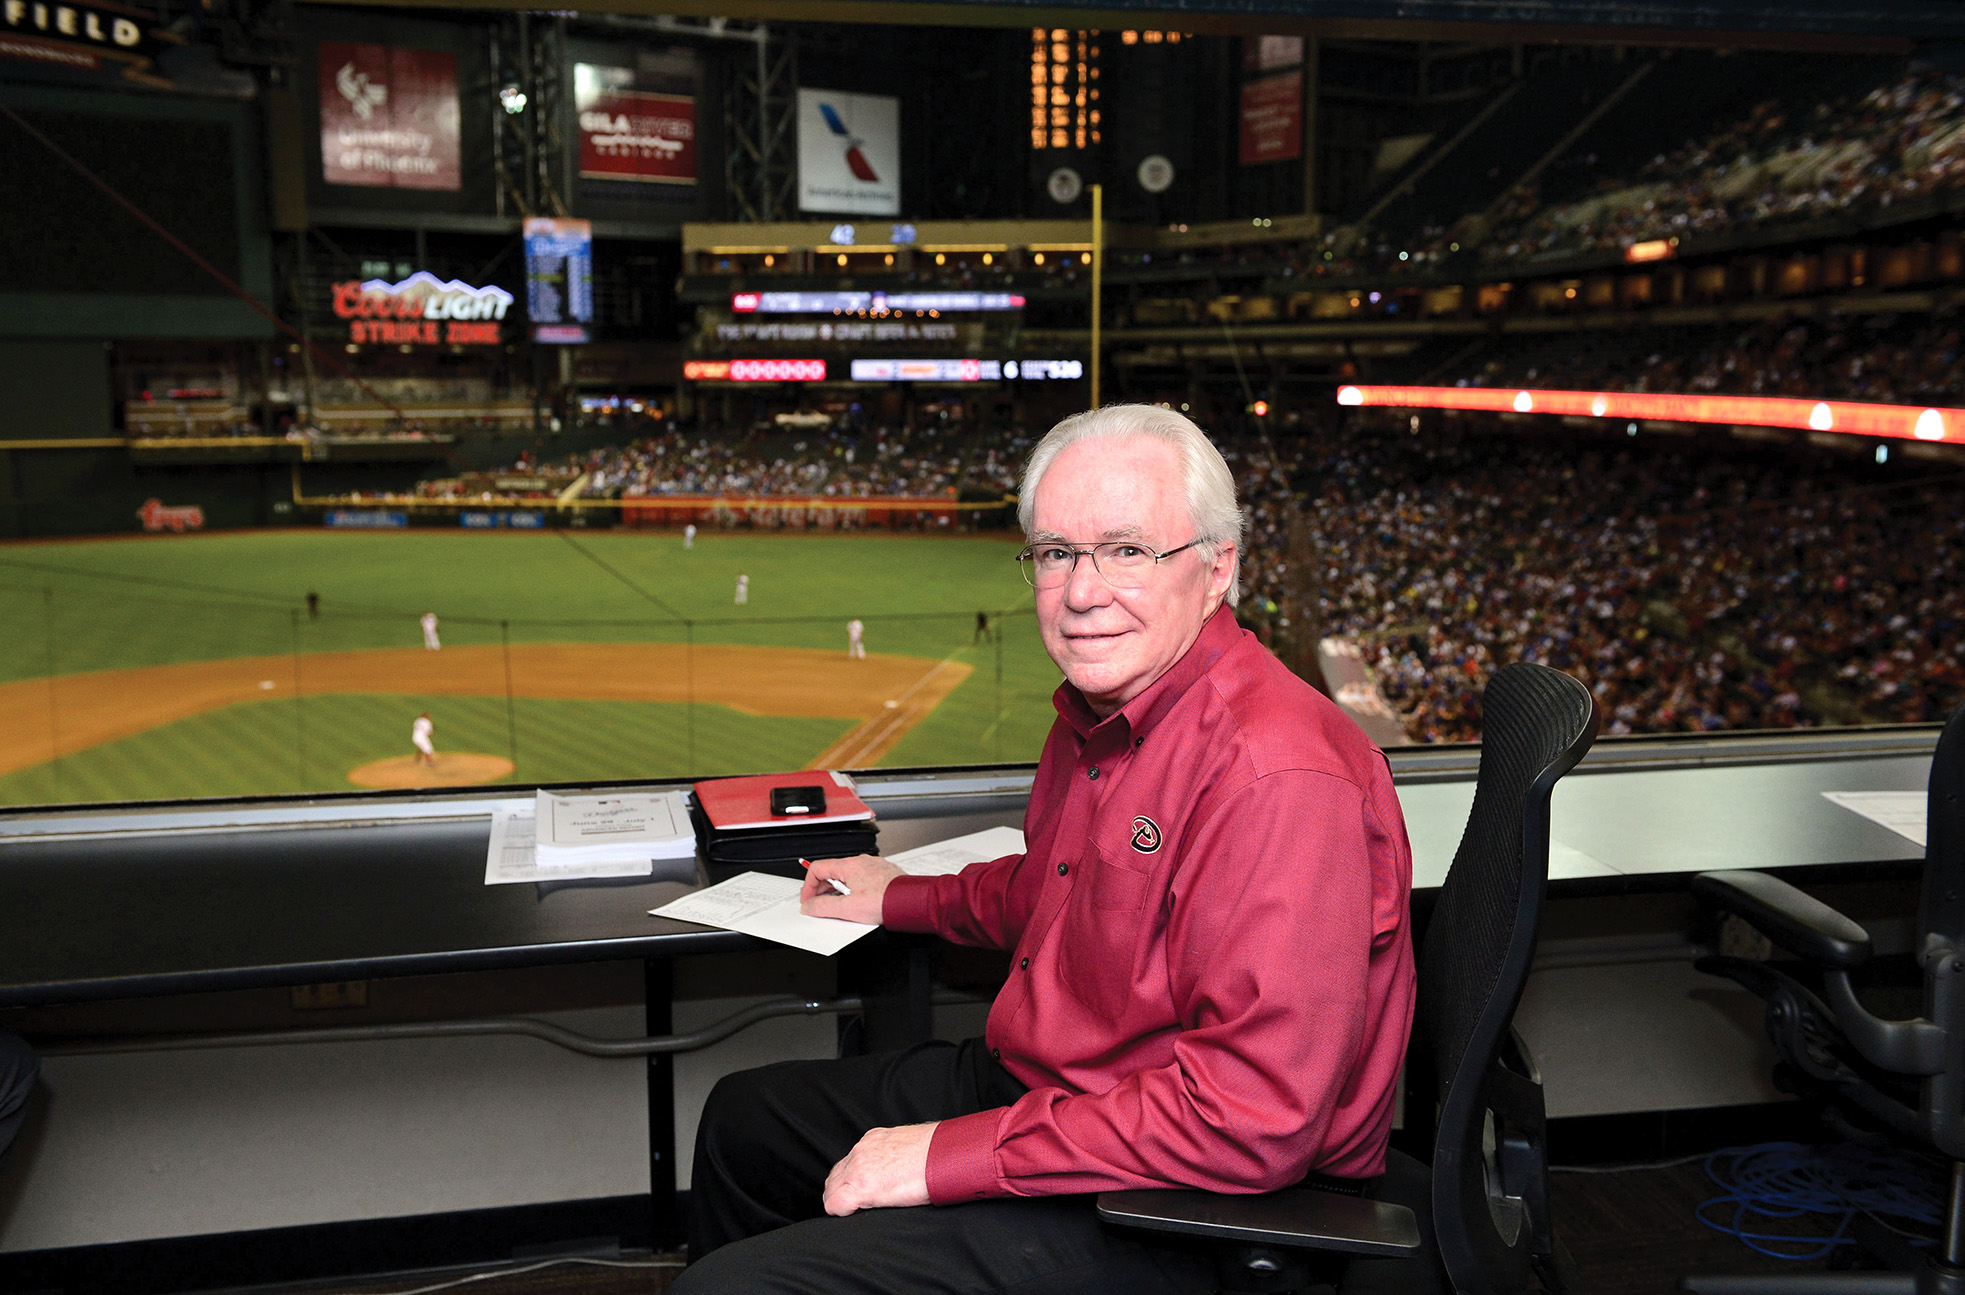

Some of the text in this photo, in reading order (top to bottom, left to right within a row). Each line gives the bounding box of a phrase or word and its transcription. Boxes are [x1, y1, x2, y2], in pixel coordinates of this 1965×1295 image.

[5, 0, 140, 46] FIELD
[579, 110, 631, 135] GILA
[423, 293, 512, 320] LIGHT
[351, 319, 440, 345] STRIKE
